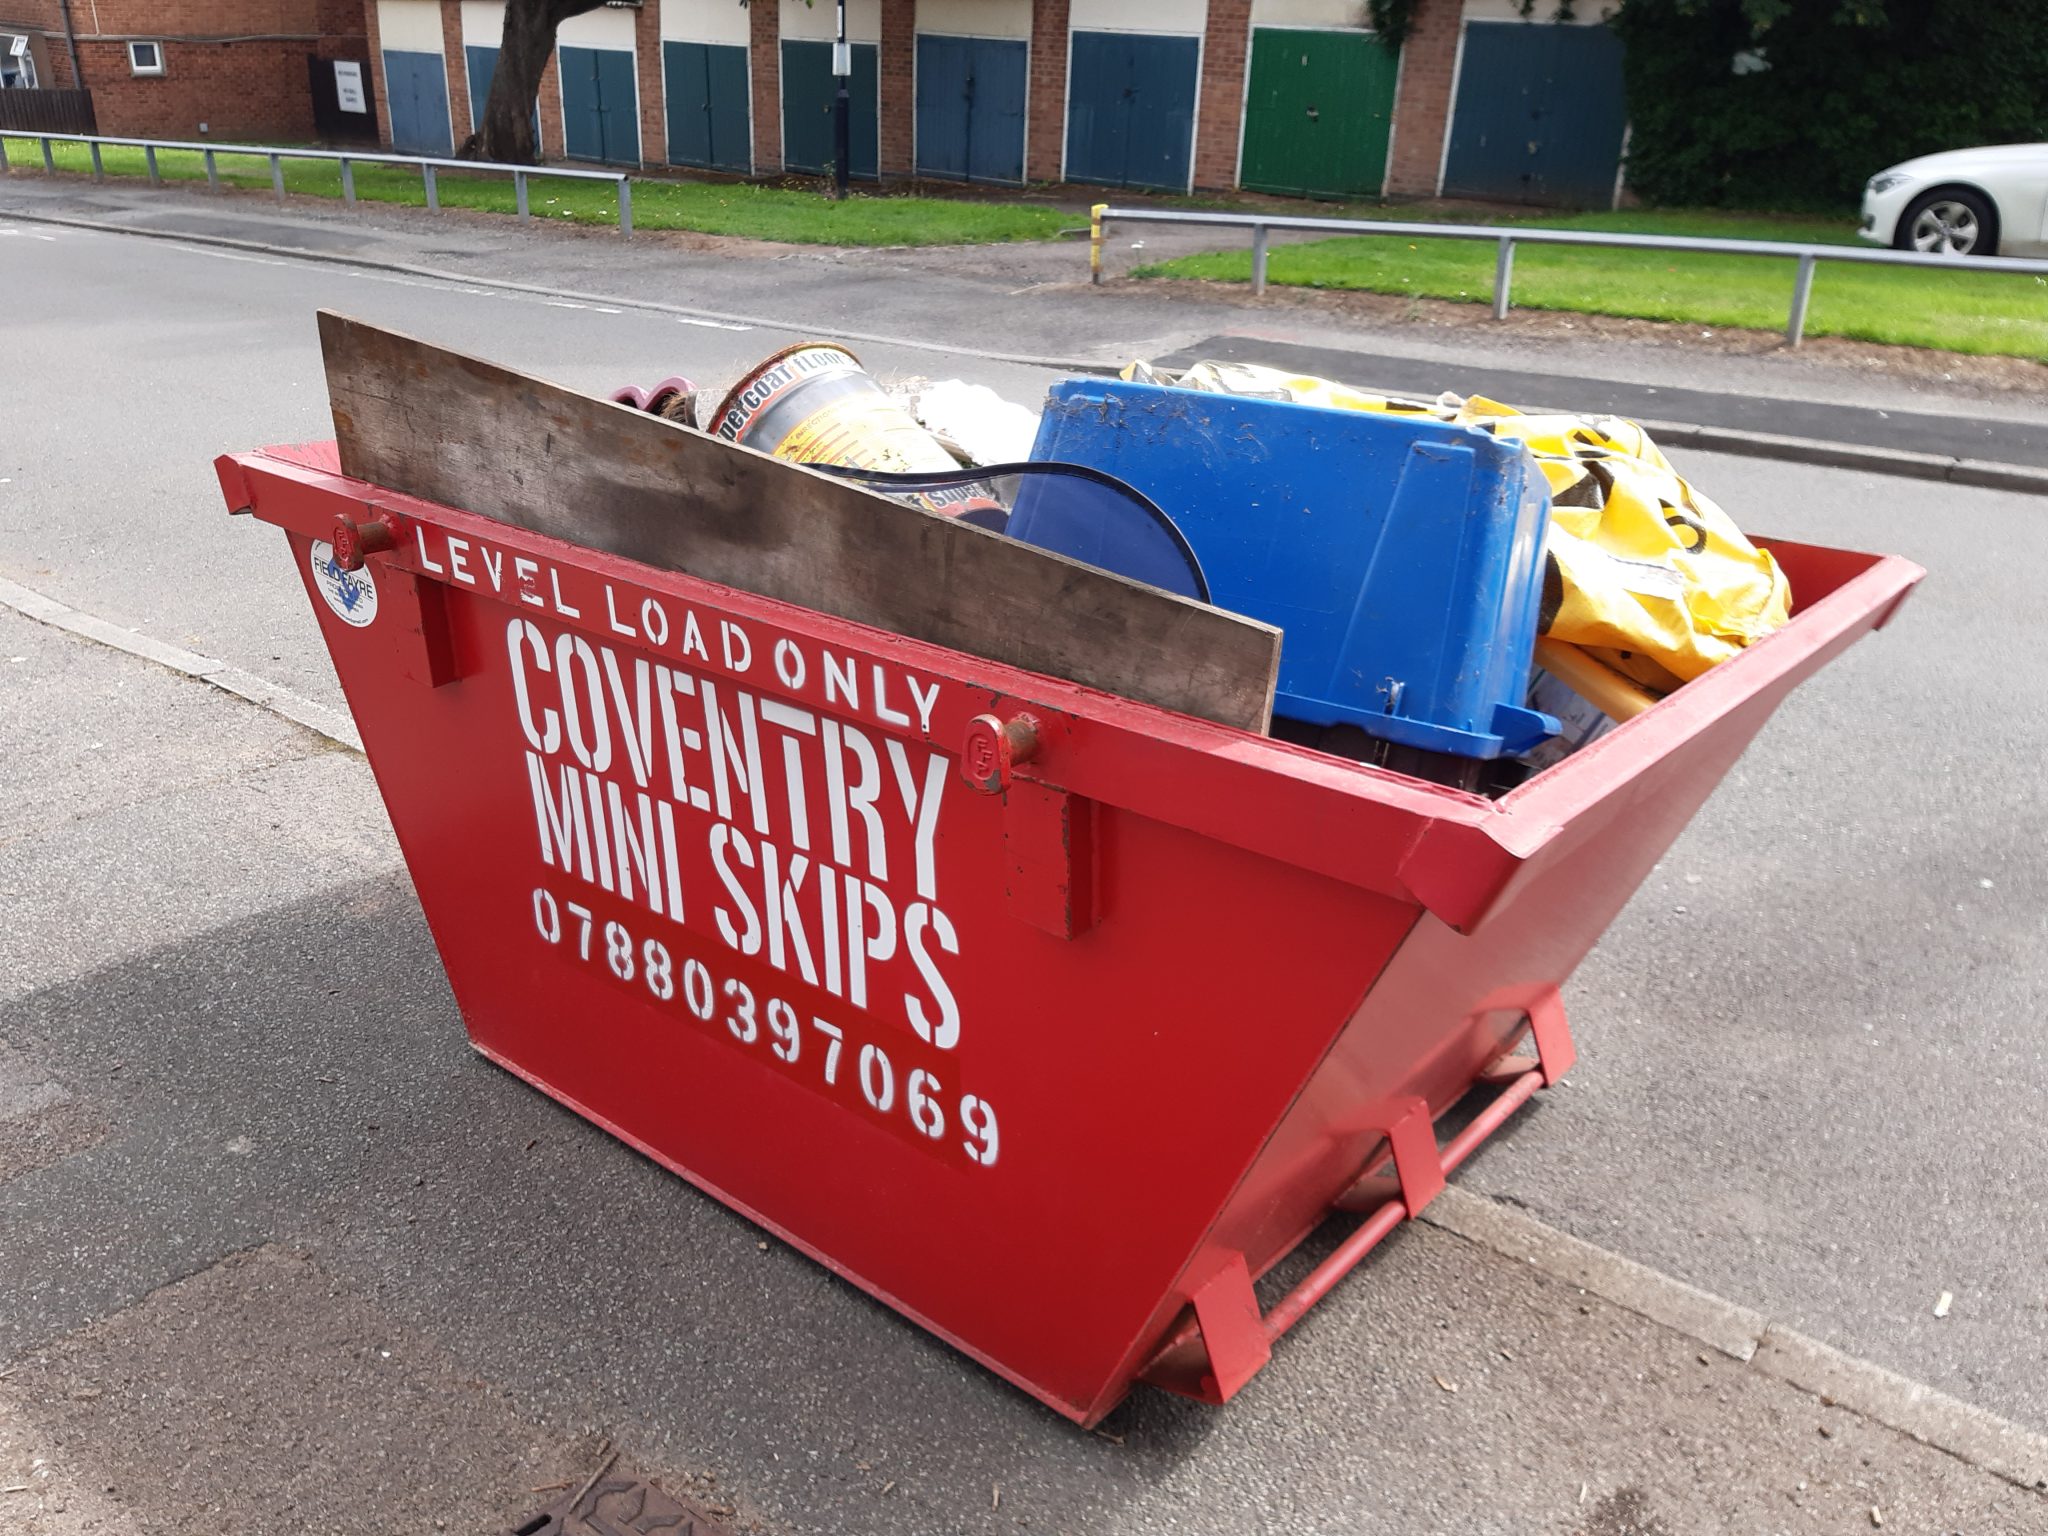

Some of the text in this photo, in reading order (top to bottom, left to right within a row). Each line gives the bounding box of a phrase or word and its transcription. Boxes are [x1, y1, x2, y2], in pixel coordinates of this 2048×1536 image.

[416, 524, 941, 734] LEVEL LOAD ONLY
[506, 618, 954, 901] COVENTRY
[525, 750, 961, 1050] MINI SKIPS
[531, 887, 1000, 1167] 07880397069
